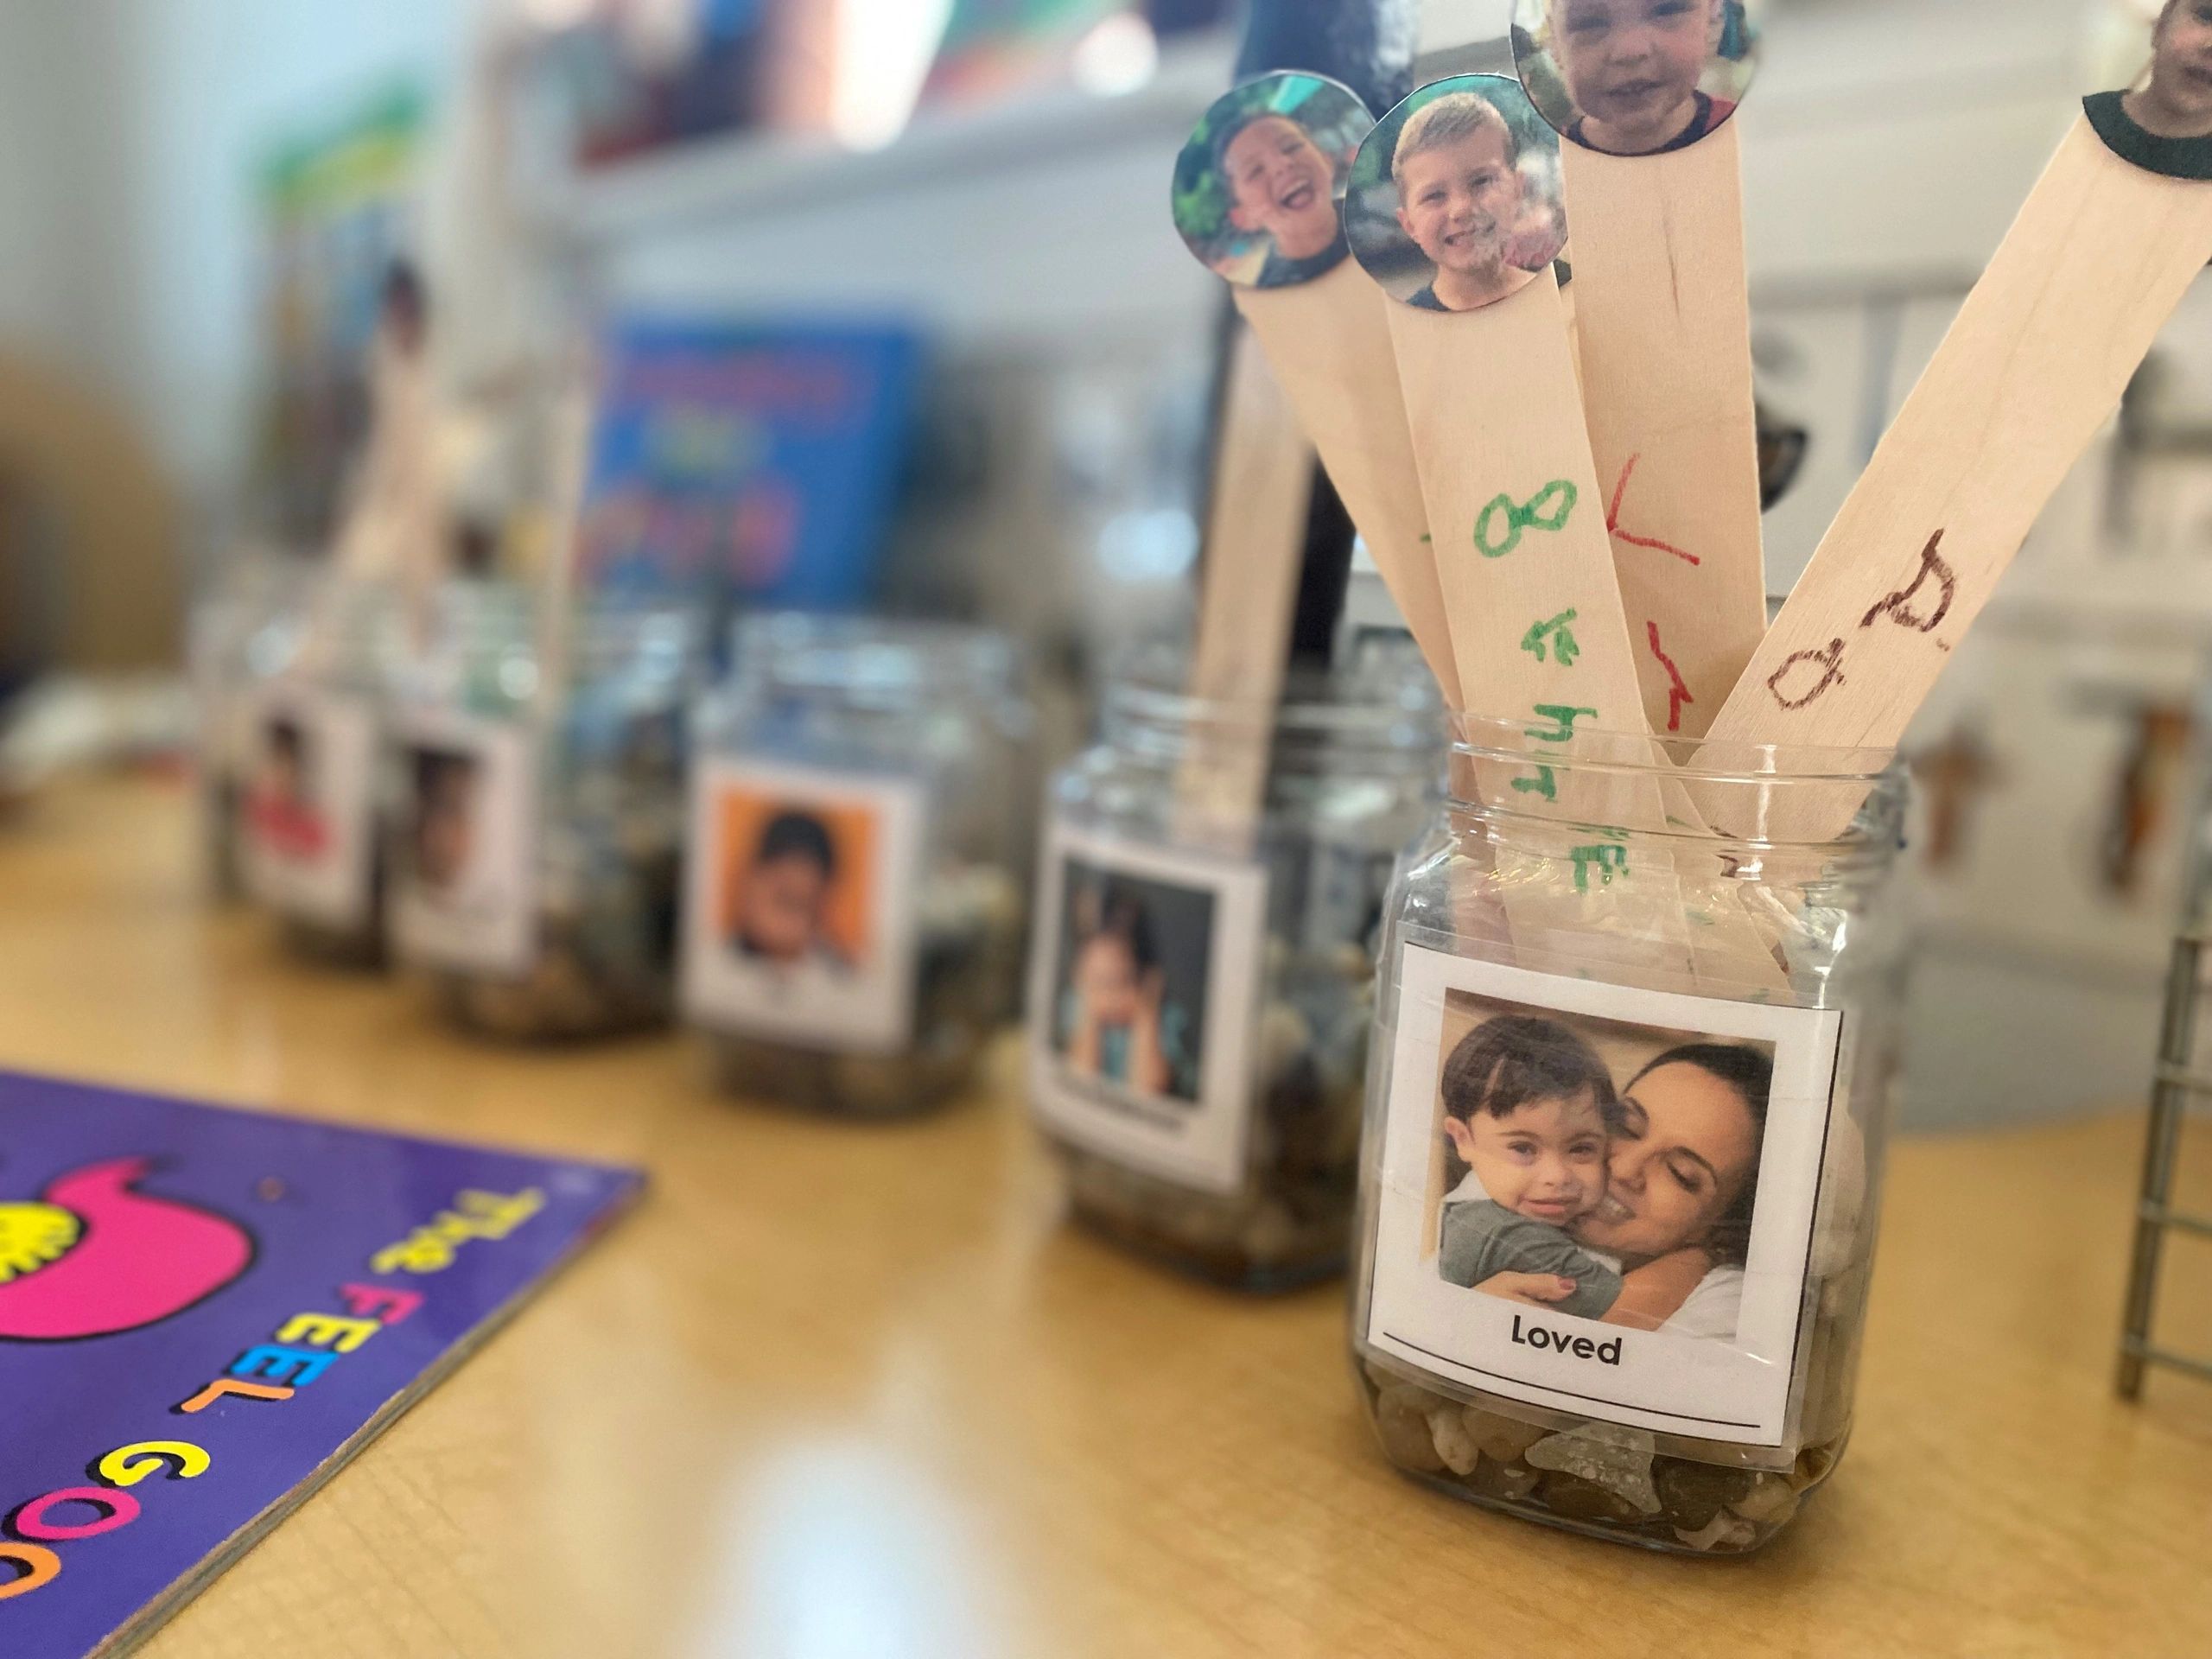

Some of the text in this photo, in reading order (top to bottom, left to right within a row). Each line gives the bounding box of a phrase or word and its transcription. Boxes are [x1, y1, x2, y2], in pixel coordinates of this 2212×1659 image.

[372, 1188, 546, 1274] The
[172, 1283, 424, 1414] FEEL
[1511, 1314, 1623, 1366] Loved
